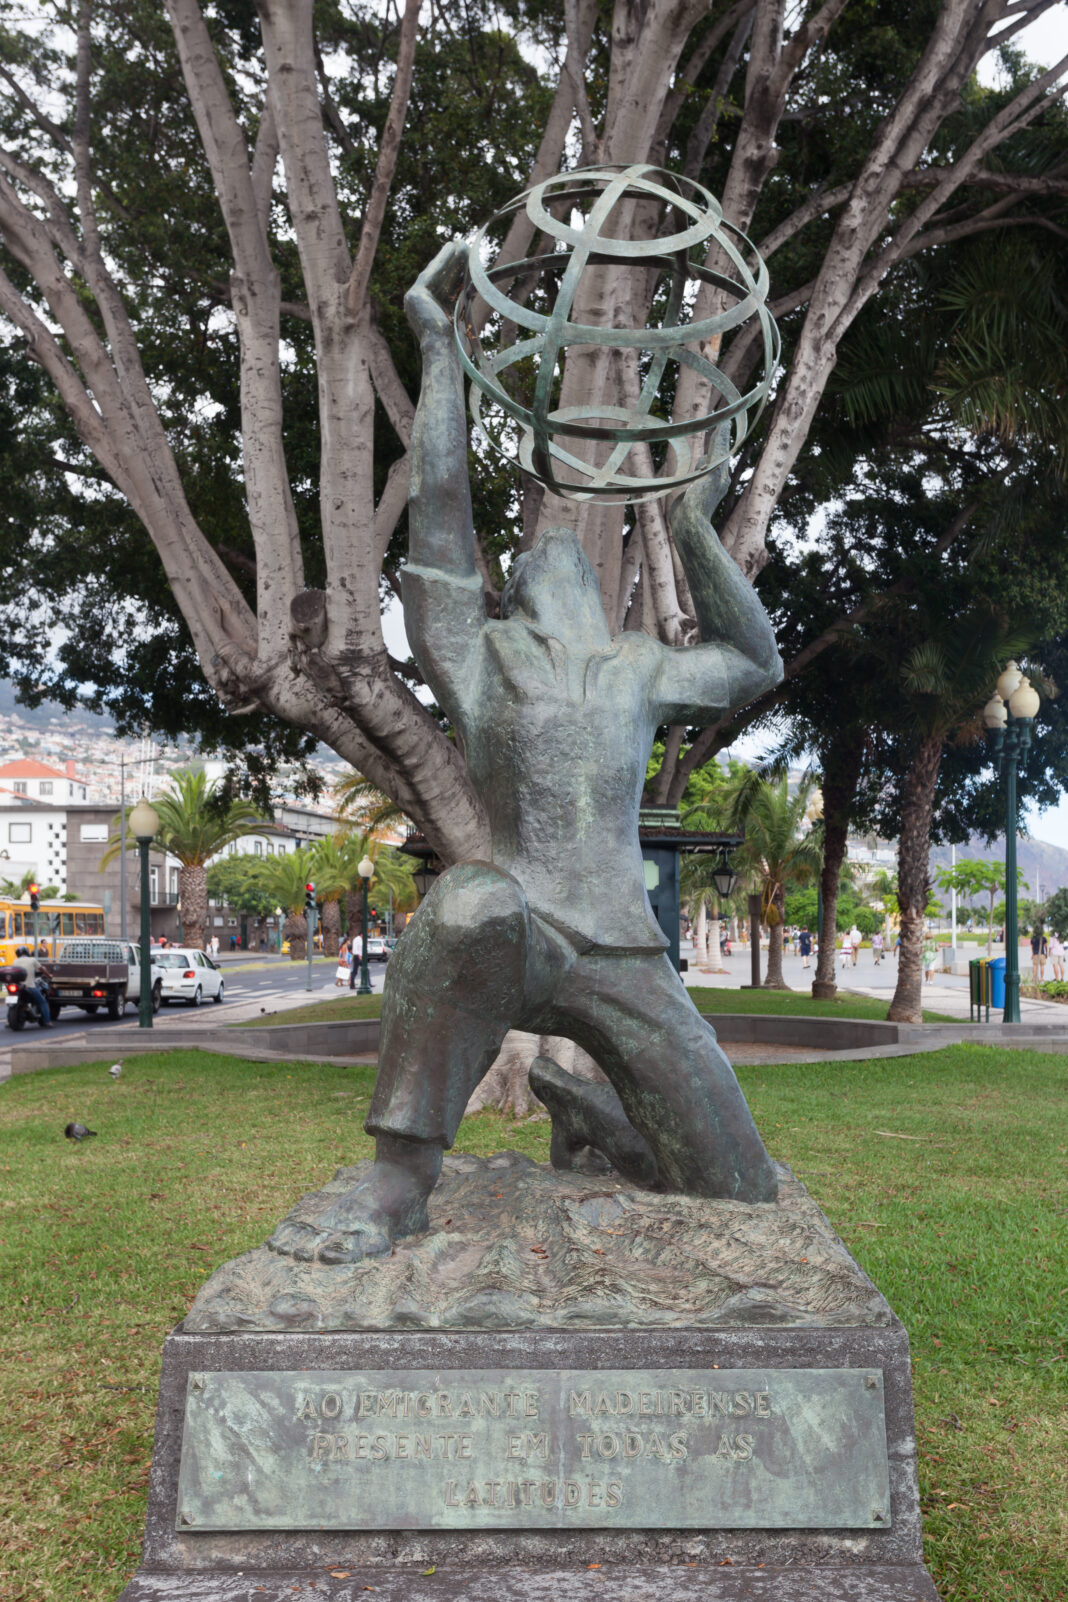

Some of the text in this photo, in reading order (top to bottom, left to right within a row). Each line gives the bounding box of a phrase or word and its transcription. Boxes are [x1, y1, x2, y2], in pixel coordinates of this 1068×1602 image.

[300, 1390, 770, 1417] AO EMIGRANTE MADEIRENSE
[313, 1432, 753, 1460] PRESENTE EM TODAS AS
[445, 1480, 622, 1507] LATITUDES
